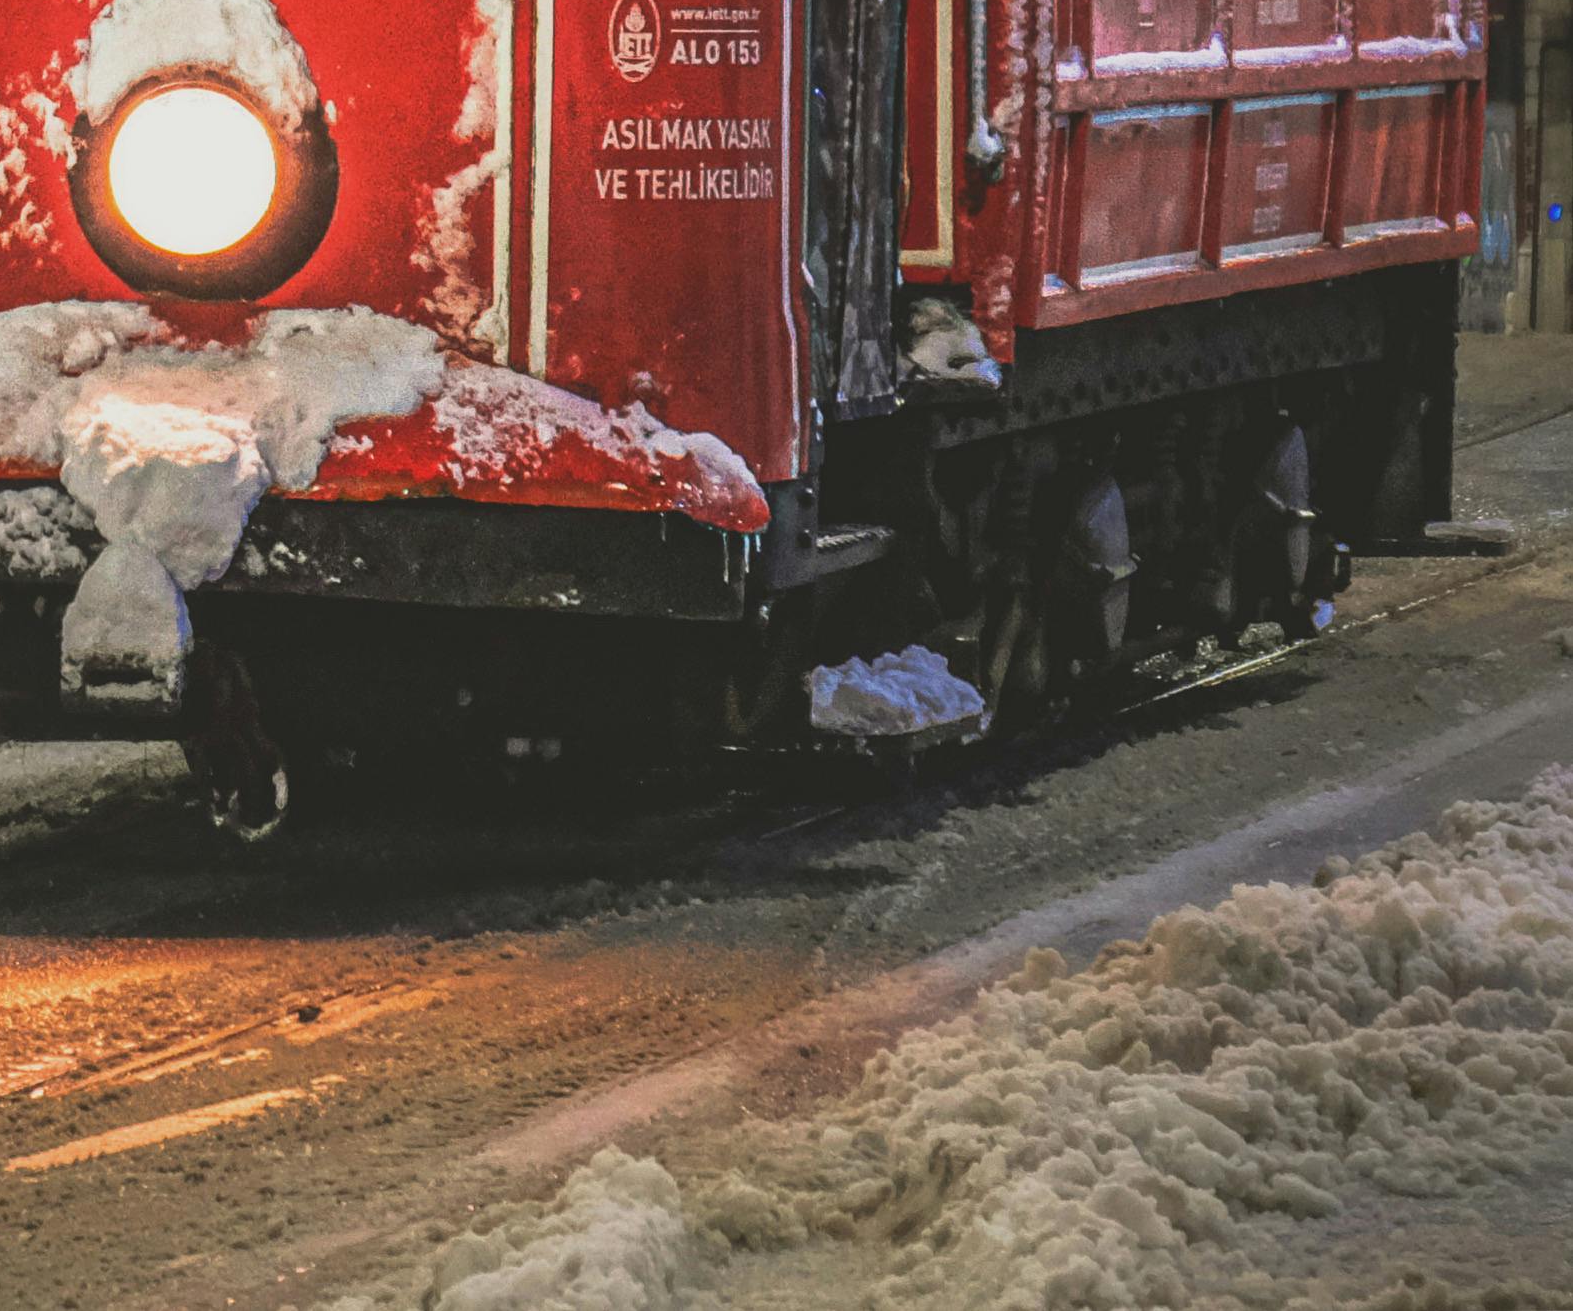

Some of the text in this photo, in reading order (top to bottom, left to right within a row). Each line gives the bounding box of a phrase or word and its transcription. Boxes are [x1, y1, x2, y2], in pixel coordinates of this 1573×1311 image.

[670, 39, 761, 65] ALO 153
[602, 118, 771, 151] ASILMAK YASAK
[595, 162, 774, 200] VE TEHLİKELİDİR
